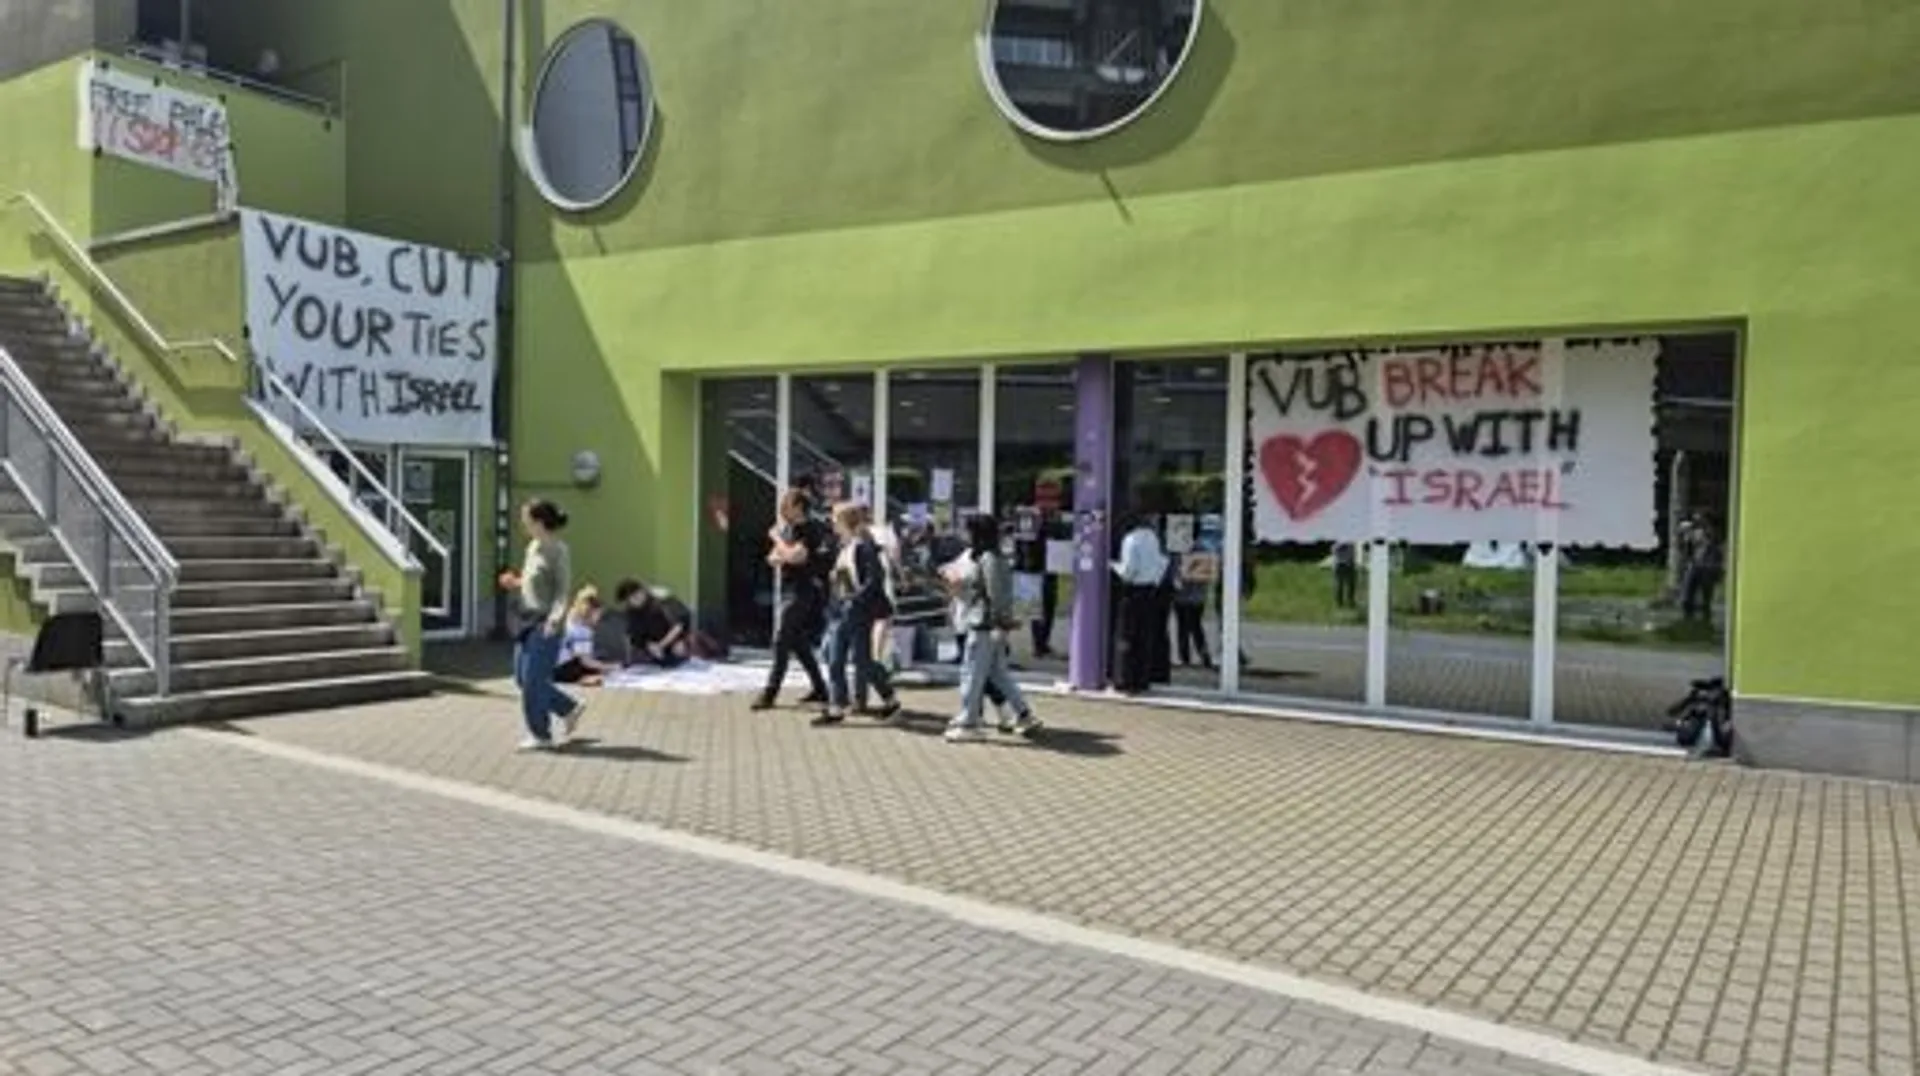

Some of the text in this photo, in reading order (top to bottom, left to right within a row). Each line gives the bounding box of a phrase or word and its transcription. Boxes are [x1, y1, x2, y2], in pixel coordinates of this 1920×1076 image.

[260, 215, 485, 298] VUB, CUT
[266, 273, 489, 361] YOUR TIES
[266, 356, 483, 418] WITH ISRAEL
[1257, 354, 1543, 420] VUB BREAK
[1366, 409, 1581, 462] UP WITH
